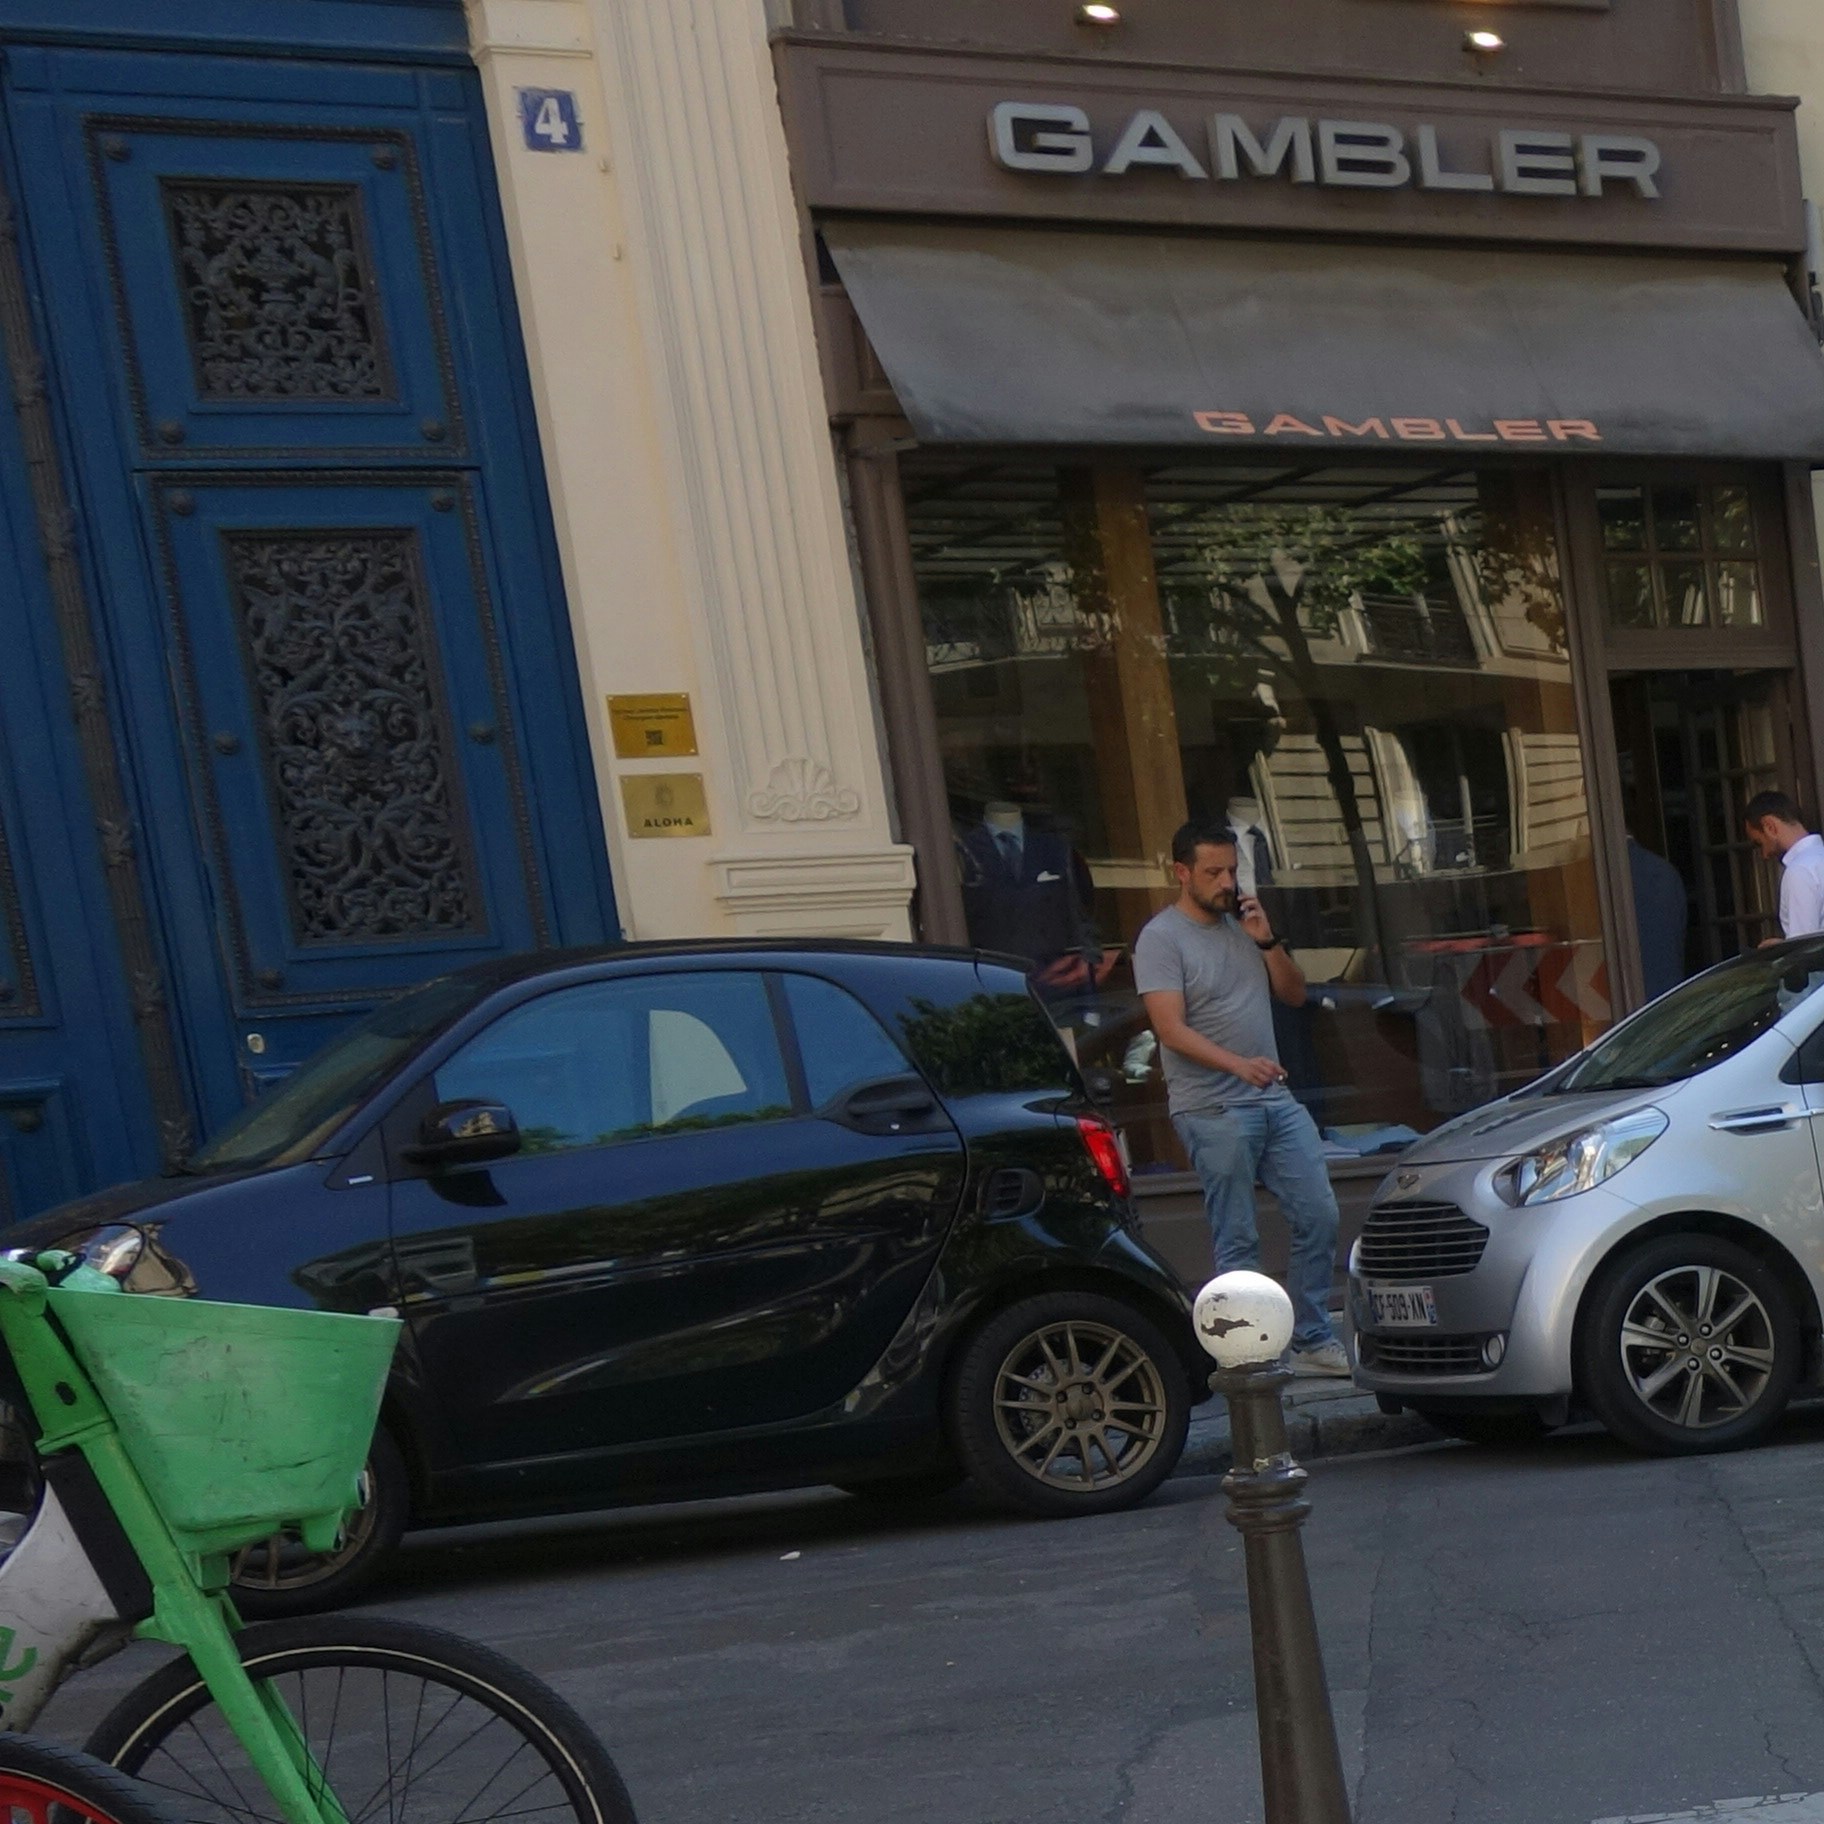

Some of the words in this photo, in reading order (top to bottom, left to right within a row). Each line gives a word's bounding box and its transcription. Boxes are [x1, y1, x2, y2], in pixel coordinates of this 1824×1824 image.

[534, 97, 569, 144] 4
[988, 102, 1662, 199] GAMBLER
[1193, 410, 1604, 442] GAMBLER
[643, 816, 694, 828] ALOHA
